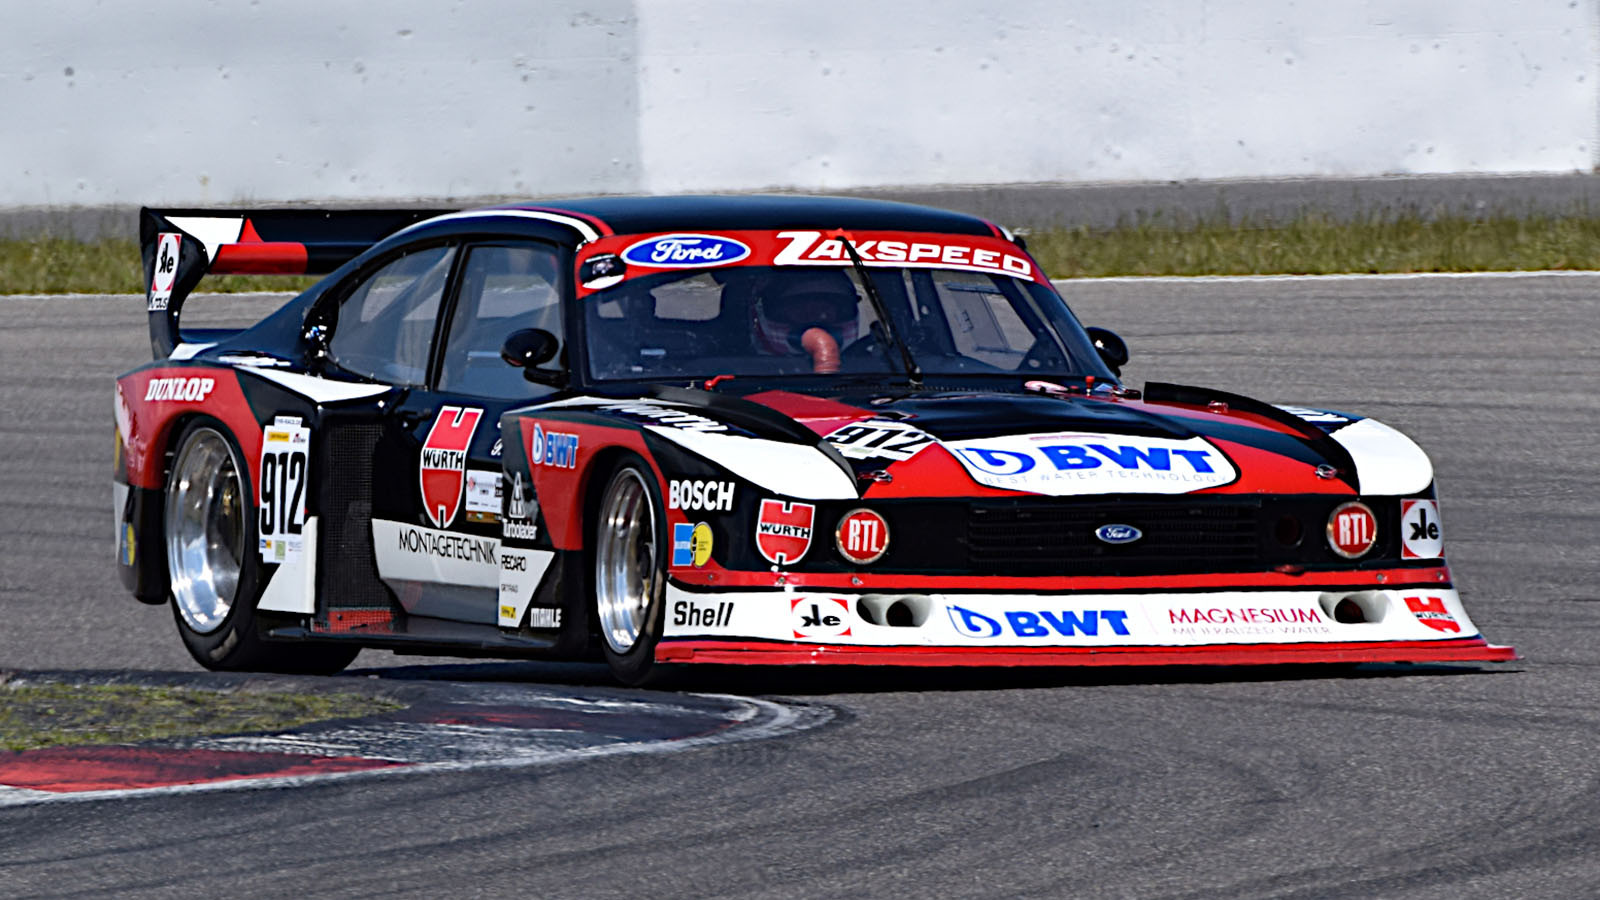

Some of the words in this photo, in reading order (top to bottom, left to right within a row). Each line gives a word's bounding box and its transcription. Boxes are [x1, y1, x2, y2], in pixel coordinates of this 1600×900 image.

[651, 239, 723, 262] Ford
[774, 231, 1034, 280] ZAKSPEED
[145, 378, 215, 401] DUNLOP
[545, 431, 580, 469] BWT
[822, 426, 936, 454] 912
[1037, 443, 1216, 474] BWT
[261, 451, 306, 536] 912
[669, 480, 735, 511] BOSCH
[848, 519, 880, 553] RTL
[1338, 512, 1371, 546] RTL
[400, 529, 497, 566] MONTAGETECHNIK
[501, 554, 527, 572] RECARO
[673, 601, 734, 627] Shell
[1003, 610, 1131, 637] BWT
[1168, 608, 1322, 624] MAGNESIUM
